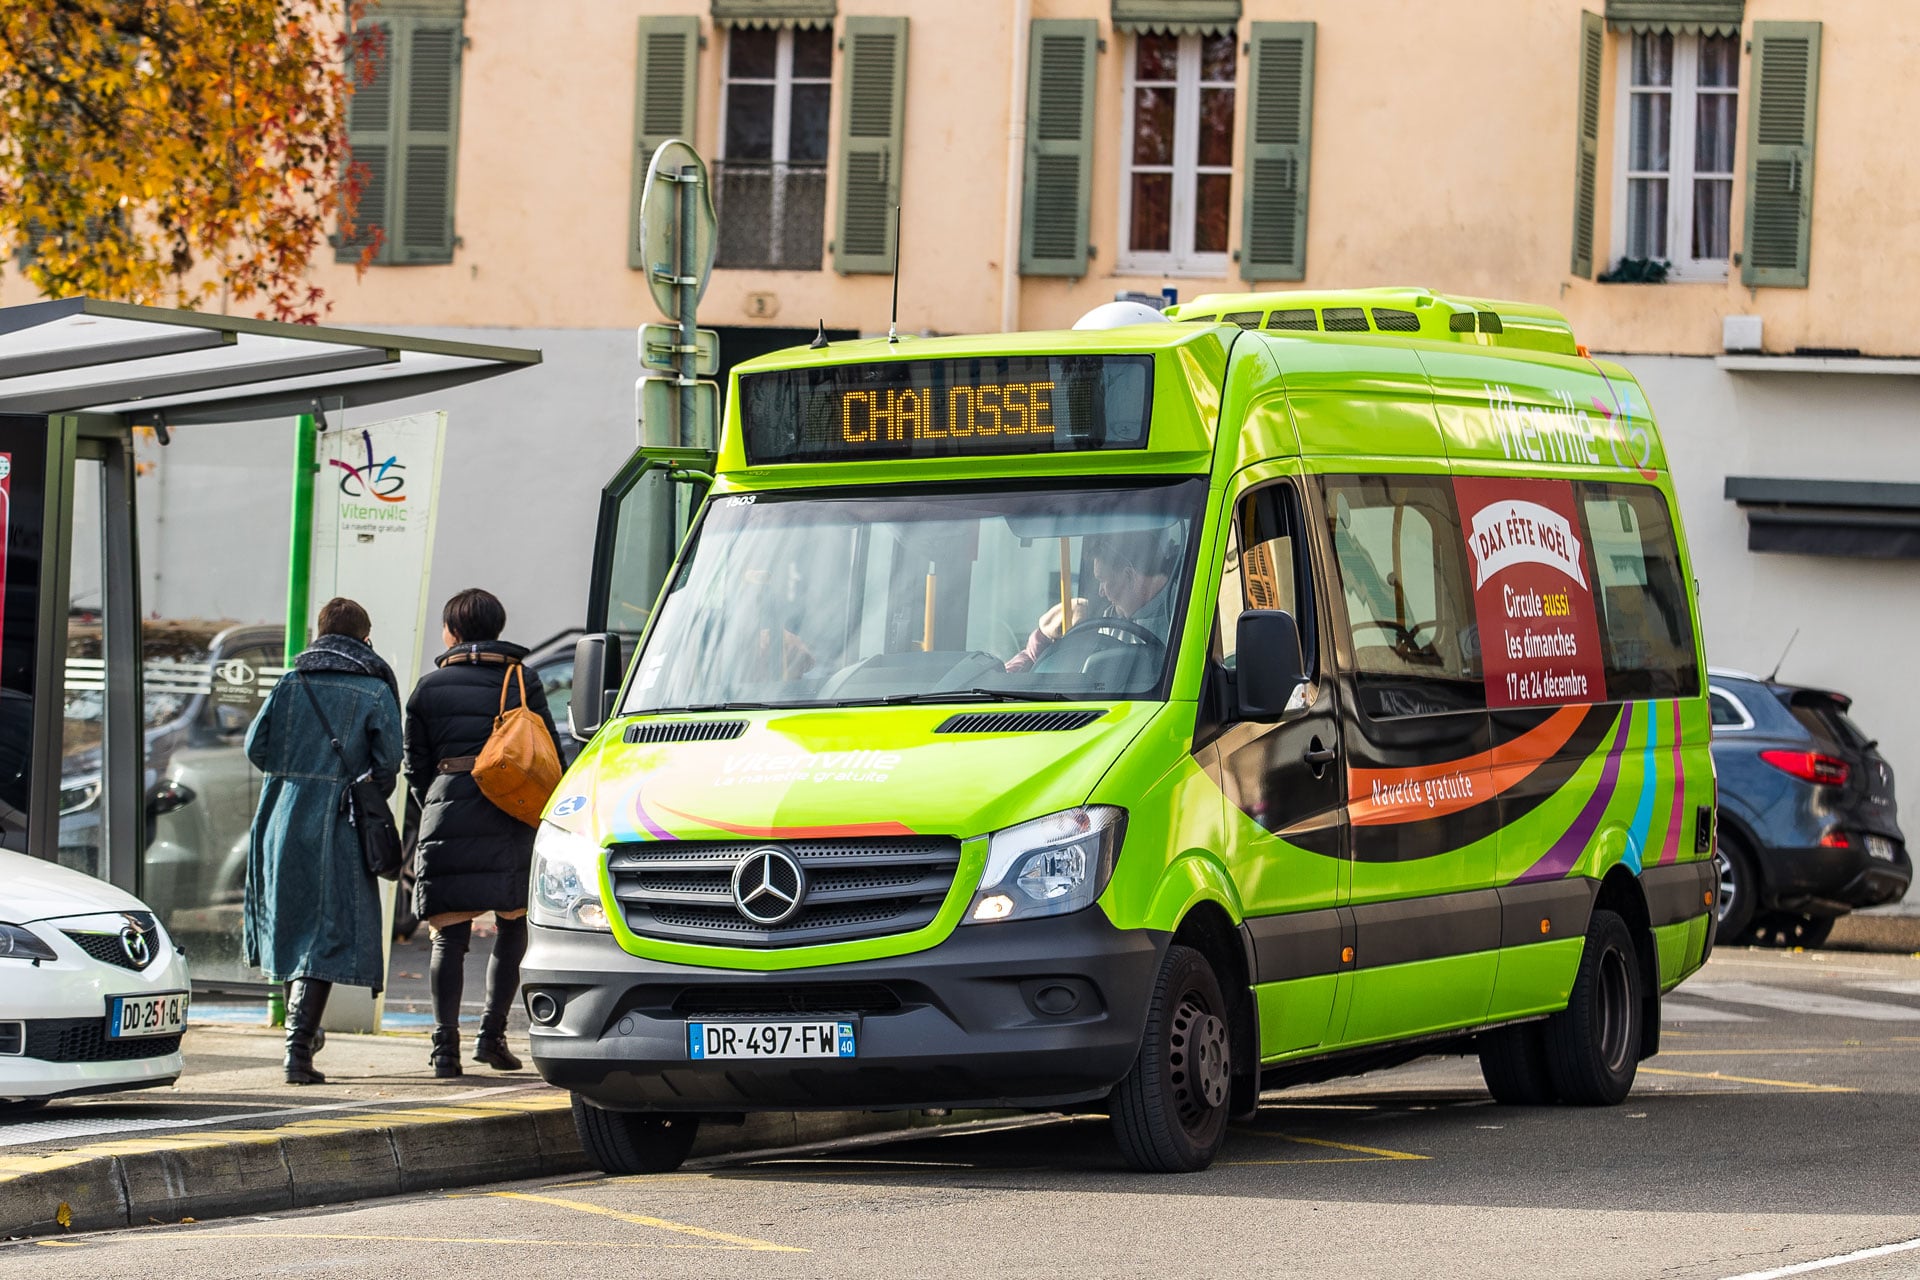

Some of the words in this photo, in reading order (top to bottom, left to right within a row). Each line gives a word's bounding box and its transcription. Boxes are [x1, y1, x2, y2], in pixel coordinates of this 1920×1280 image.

[843, 381, 1056, 442] CHALOSSE
[1484, 383, 1600, 464] Vitenville
[726, 495, 757, 508] 1503
[1478, 522, 1506, 561] DAX
[1506, 508, 1536, 546] FÊTE
[1537, 523, 1570, 562] NOËL
[1503, 583, 1543, 619] Circule
[1543, 586, 1570, 617] aussi
[1505, 629, 1523, 660] les
[1524, 627, 1577, 658] dimanches
[1506, 672, 1517, 700] 17
[1519, 675, 1529, 699] et
[1530, 671, 1542, 699] 24
[1543, 668, 1588, 698] décembre
[722, 749, 901, 774] Vitenville
[813, 769, 889, 783] gratuite
[1372, 778, 1422, 806] Navette
[1425, 770, 1473, 808] gratuite
[123, 999, 181, 1030] DD-251-GL
[694, 1045, 700, 1053] F
[706, 1025, 834, 1055] DR-497-FW
[841, 1041, 853, 1053] 40
